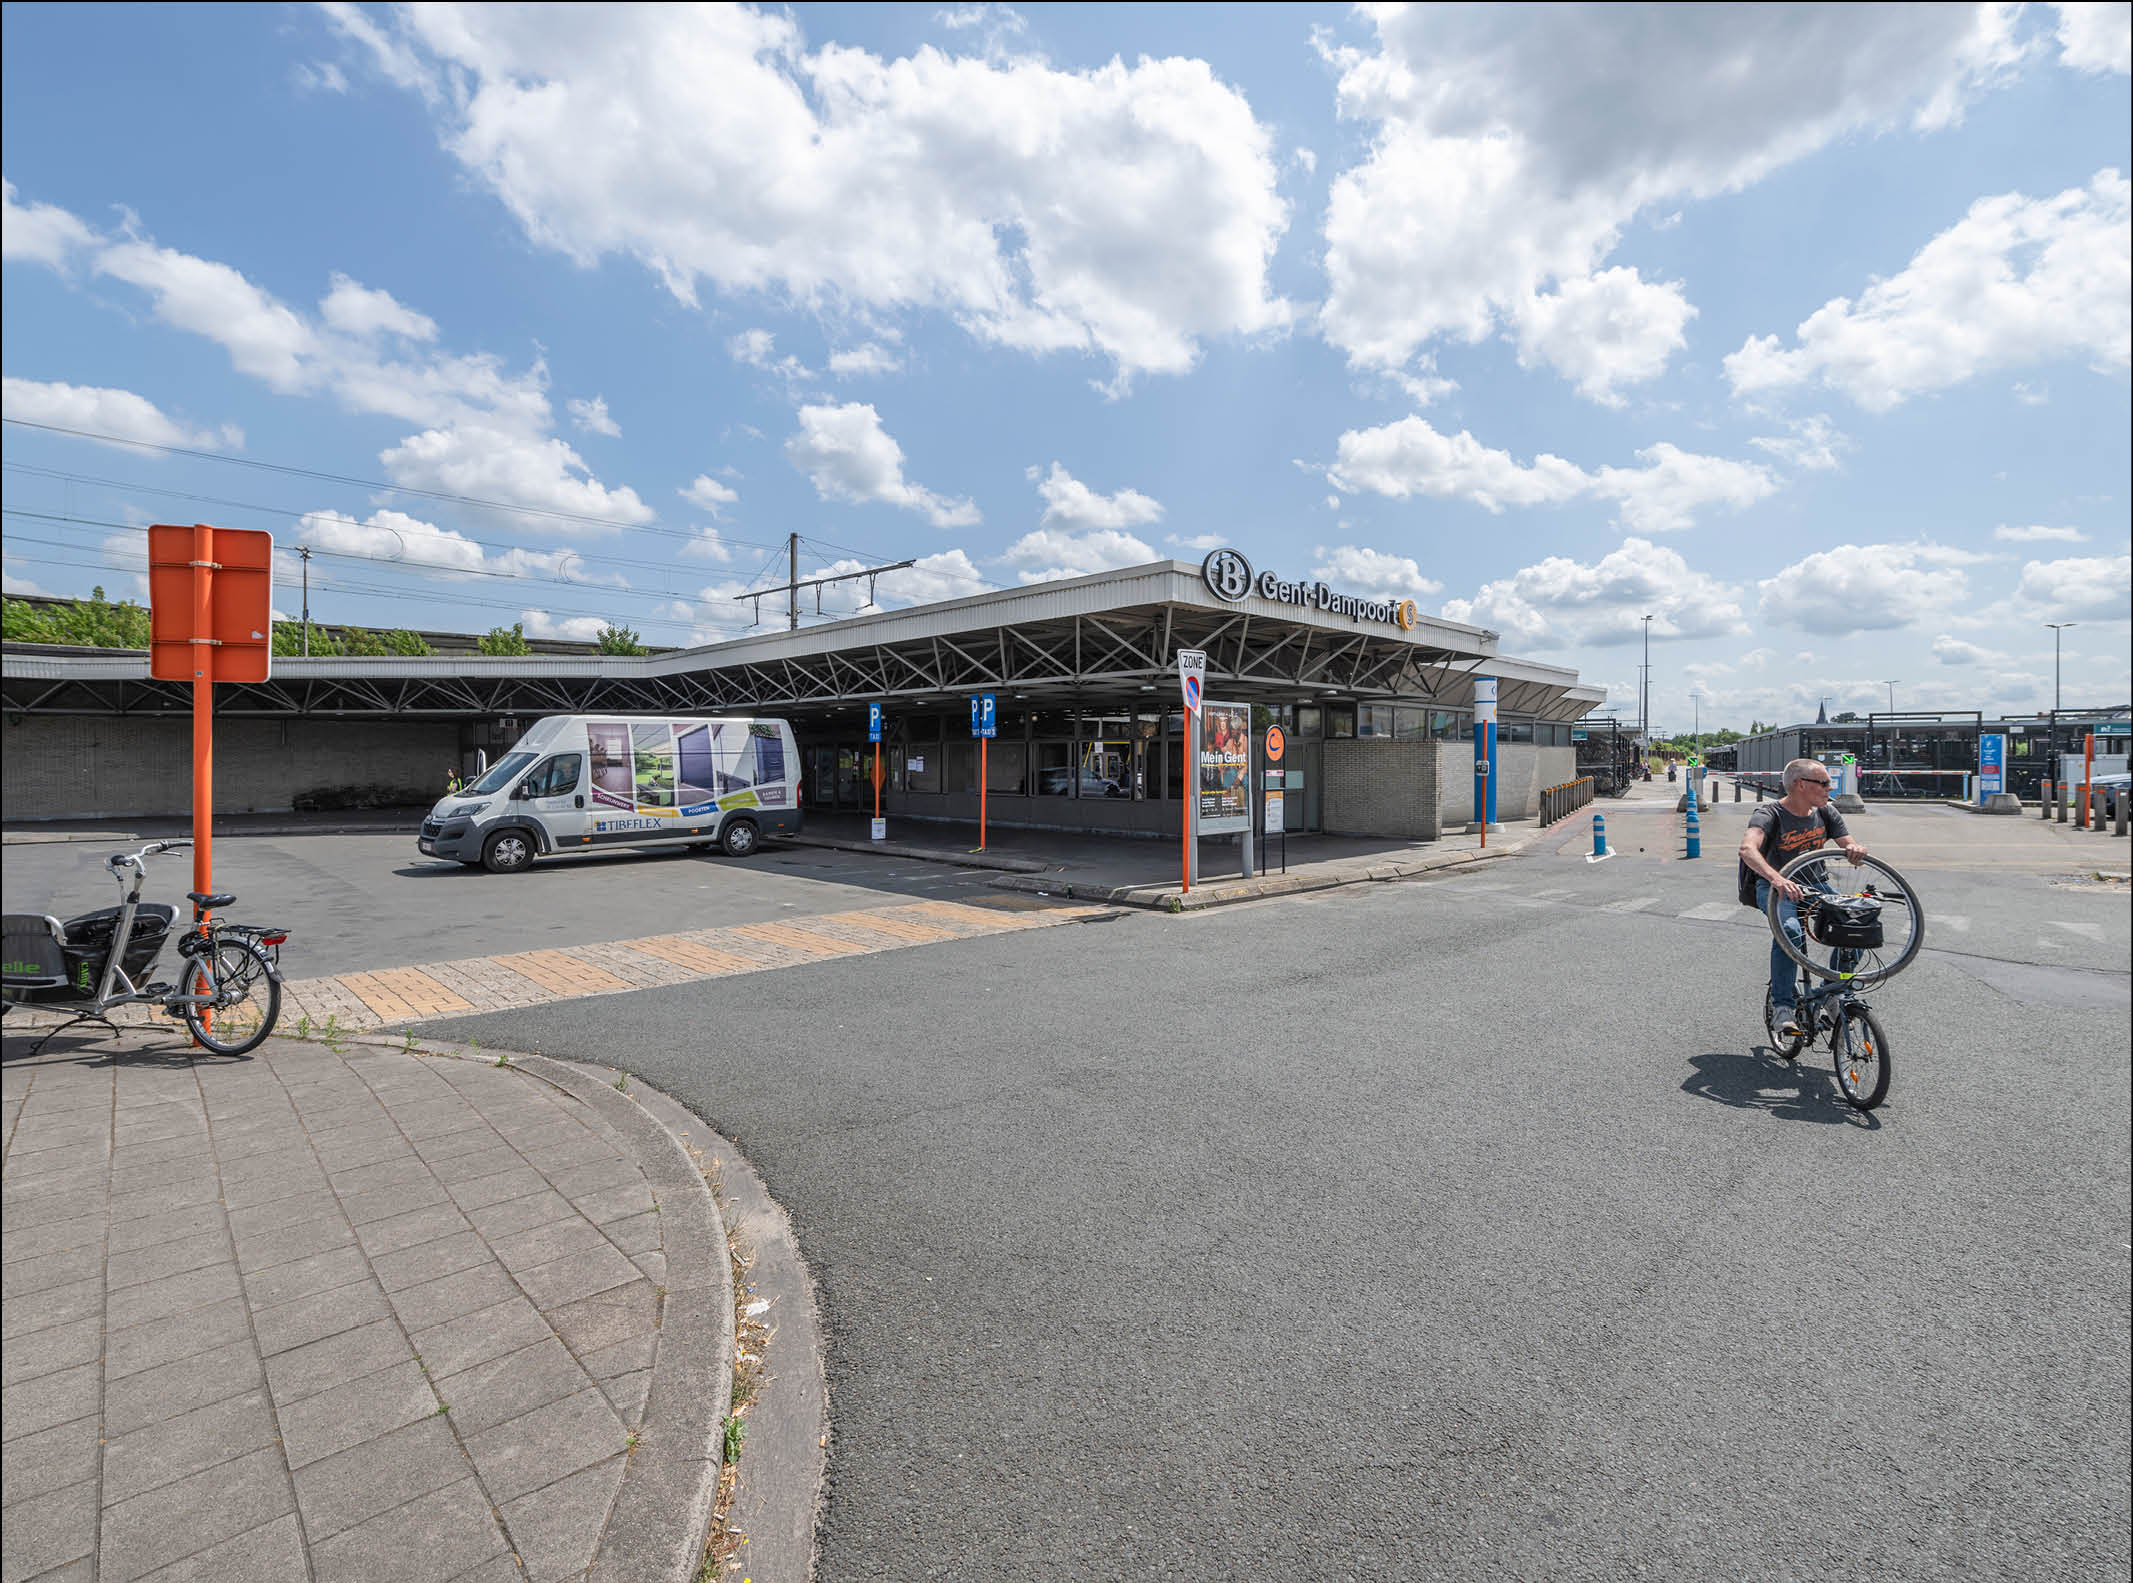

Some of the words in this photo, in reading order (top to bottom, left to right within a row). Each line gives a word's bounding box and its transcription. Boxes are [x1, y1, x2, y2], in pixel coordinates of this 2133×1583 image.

[1258, 570, 1400, 625] Gent-Dampoort
[1183, 655, 1204, 669] ZONE
[871, 707, 879, 728] P
[971, 699, 978, 721] P
[983, 698, 993, 721] P
[1201, 751, 1223, 764] Mein
[1224, 751, 1247, 764] Gent
[608, 817, 662, 832] TIBEFLEX
